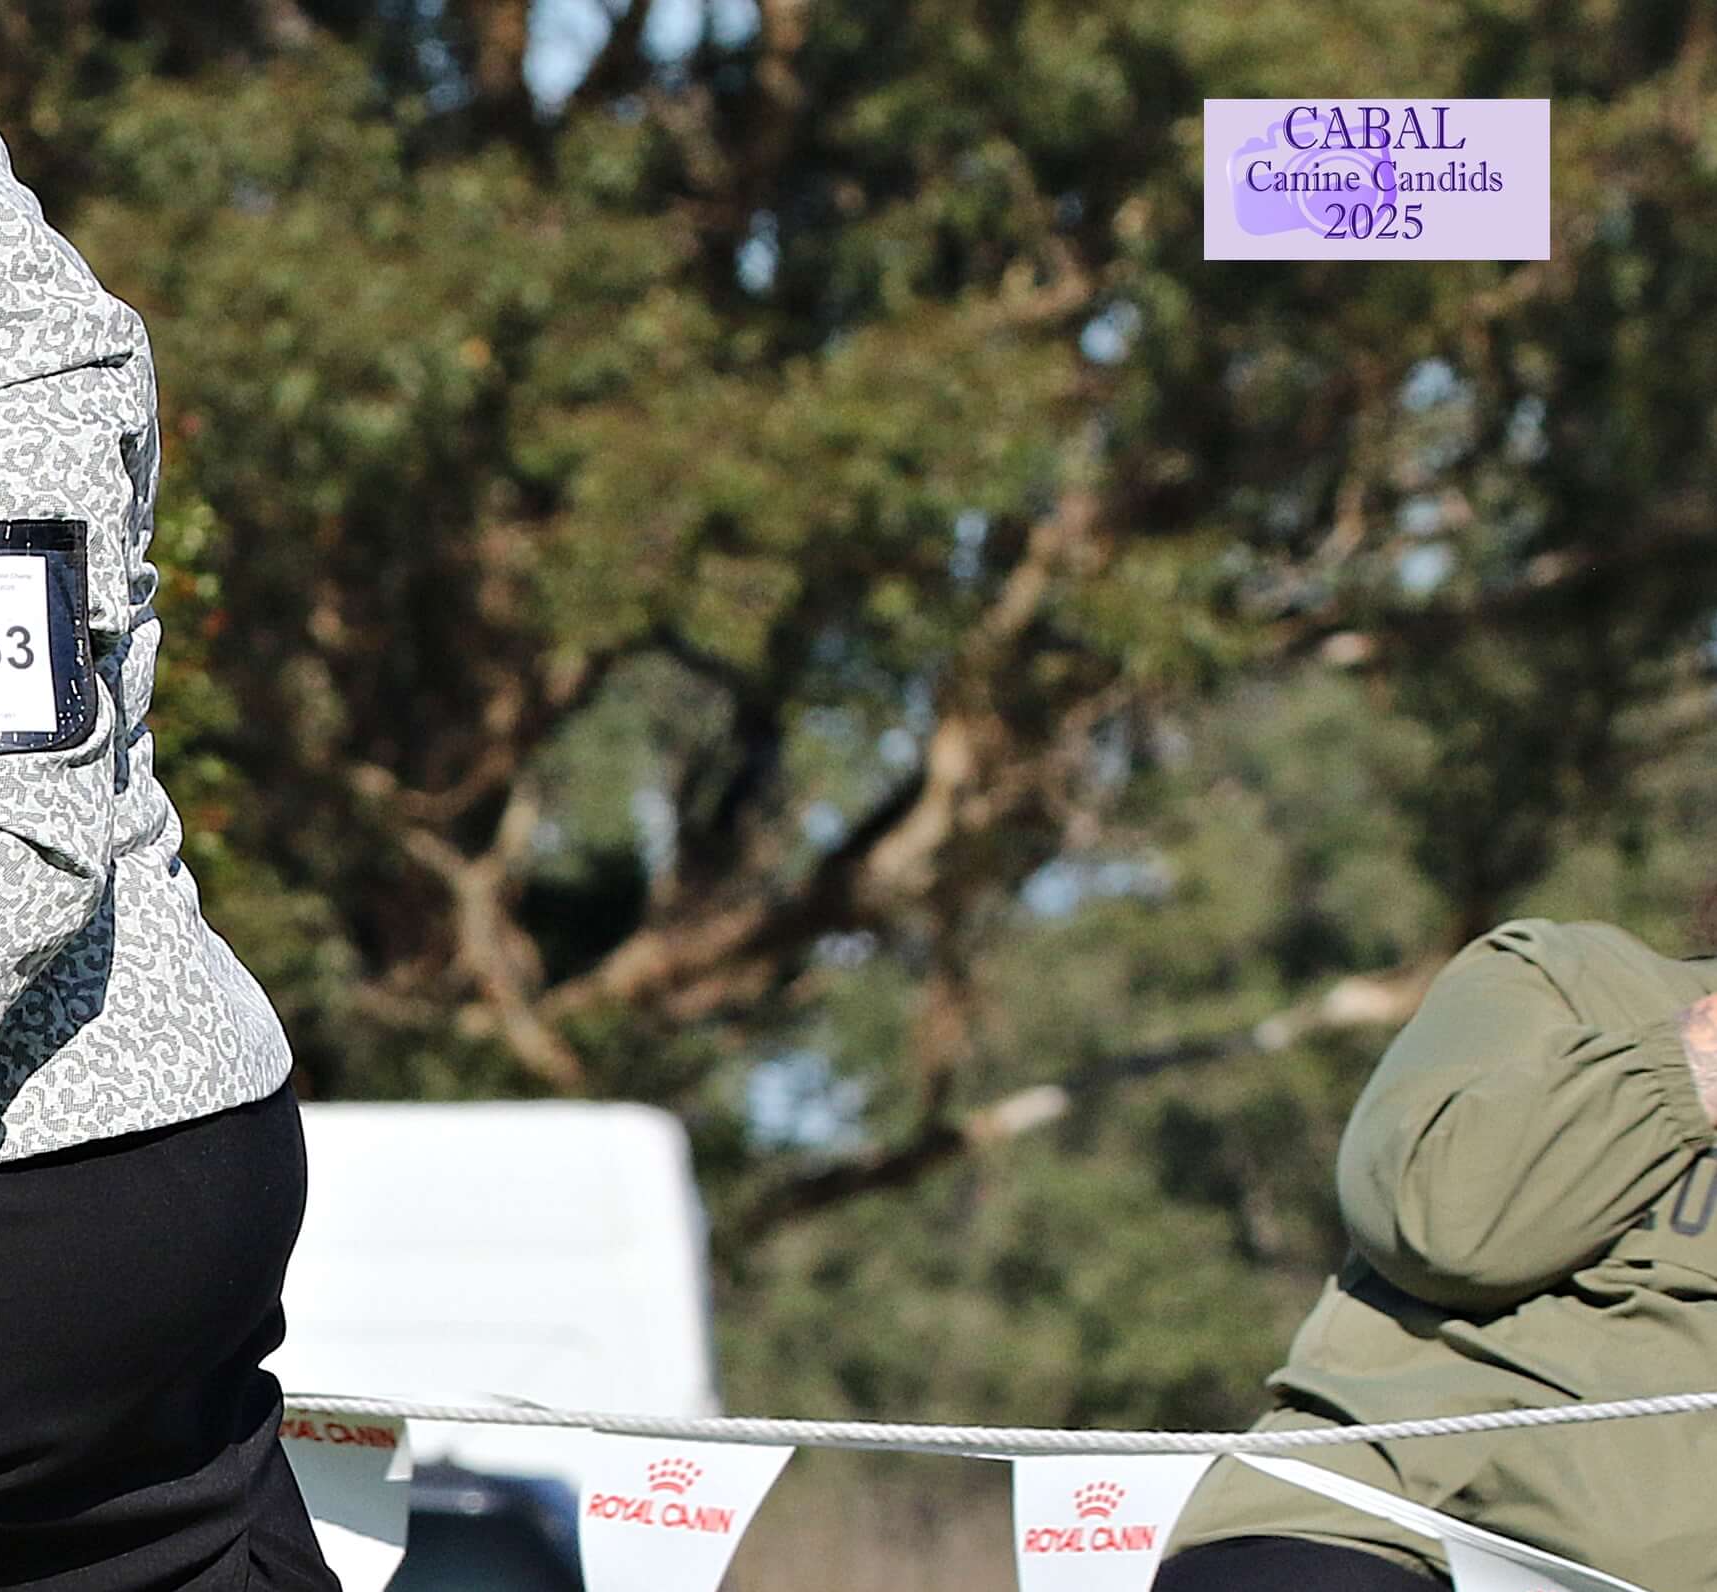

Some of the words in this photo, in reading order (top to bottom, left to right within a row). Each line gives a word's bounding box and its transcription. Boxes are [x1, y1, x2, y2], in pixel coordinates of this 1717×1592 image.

[586, 1493, 654, 1524] ROYAL
[662, 1503, 736, 1534] CANIN
[1025, 1527, 1085, 1553] ROYAL
[1091, 1526, 1157, 1551] CANIN
